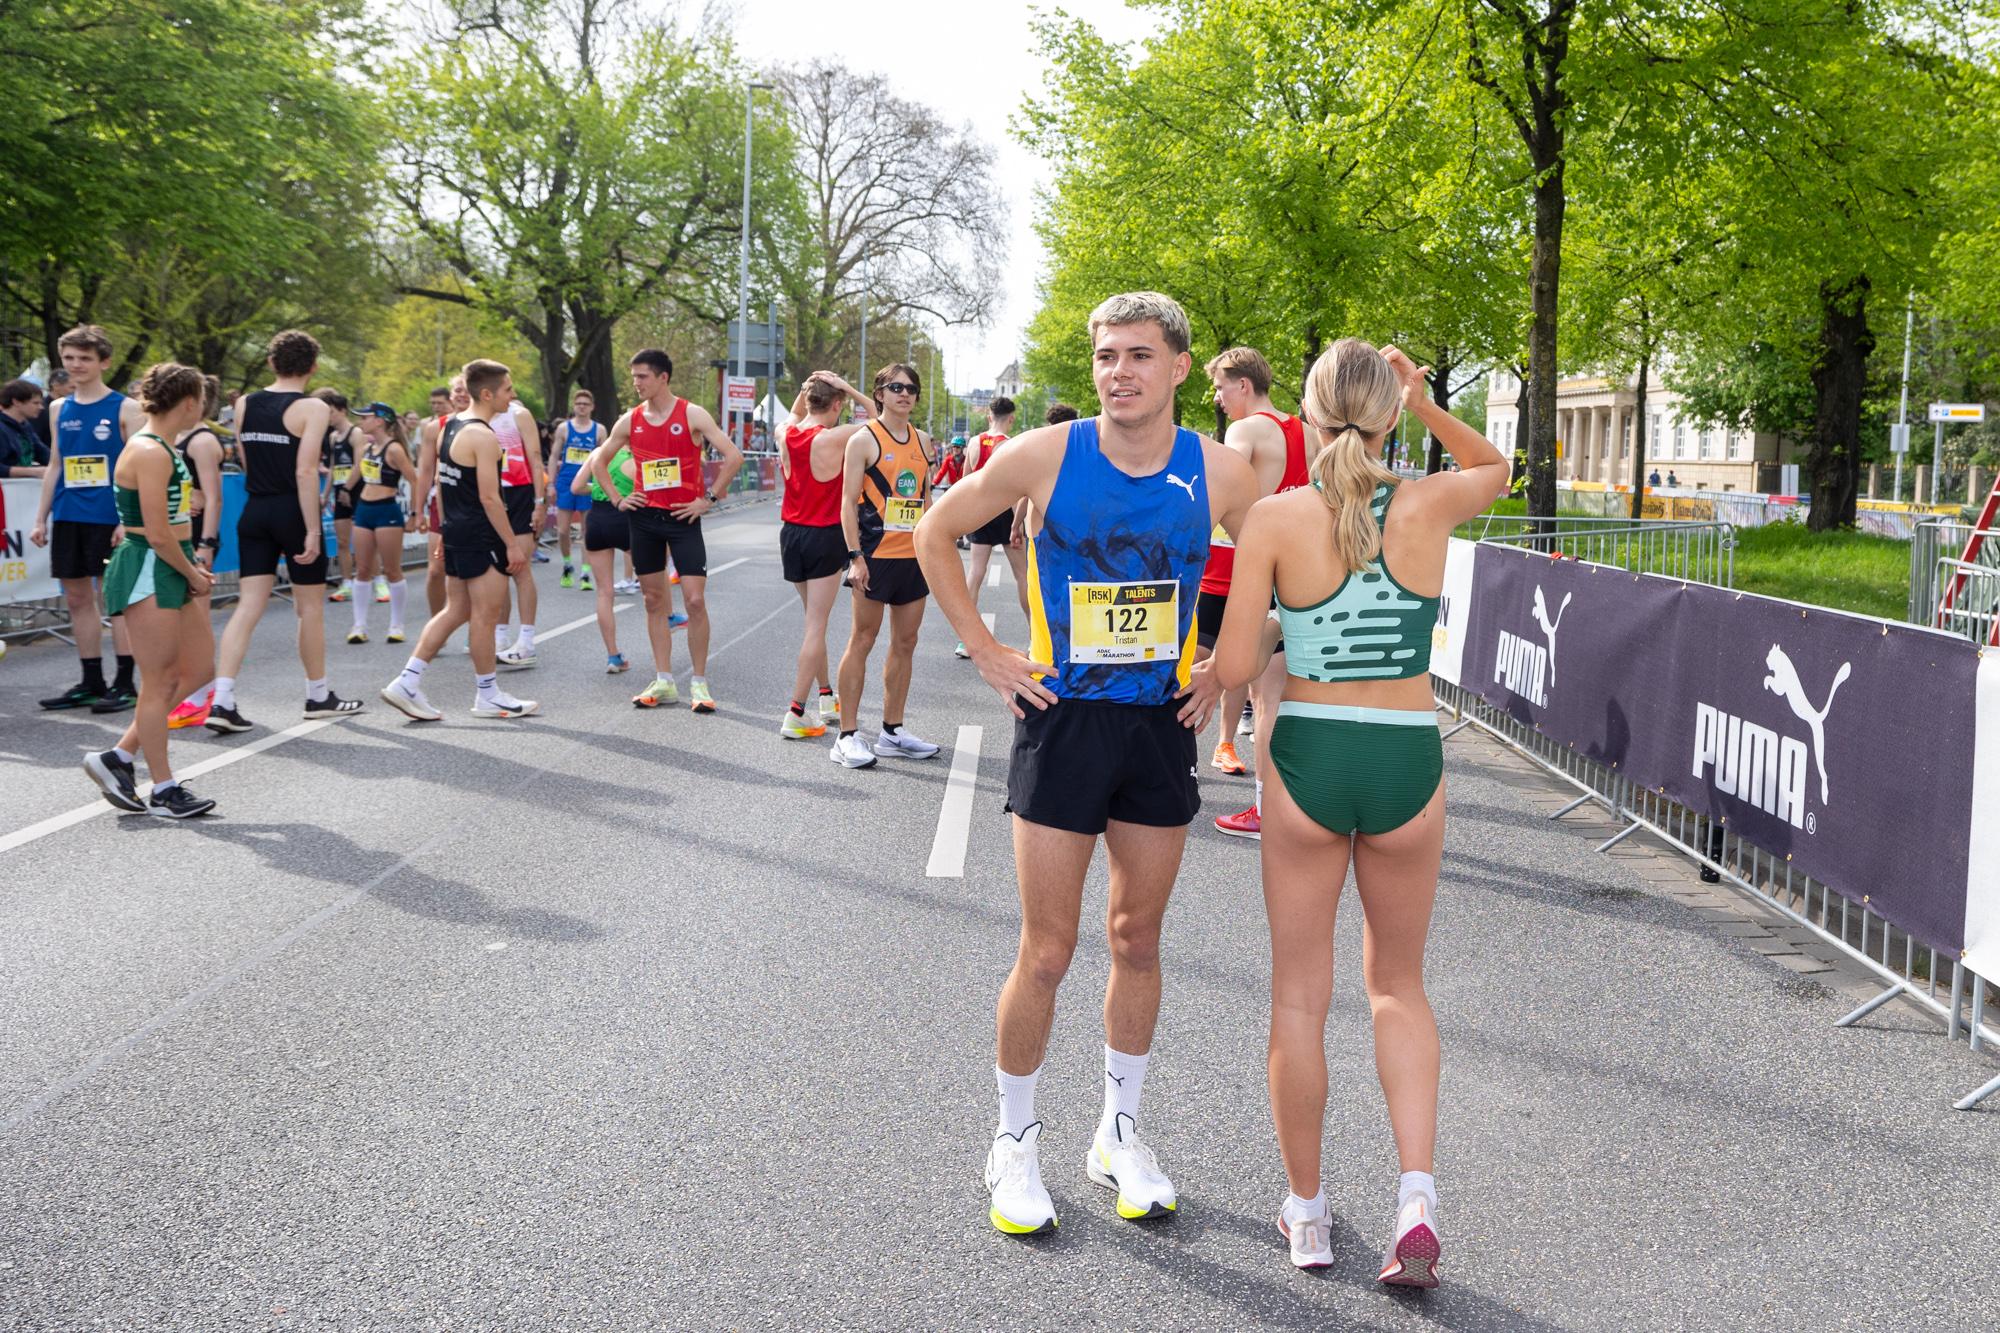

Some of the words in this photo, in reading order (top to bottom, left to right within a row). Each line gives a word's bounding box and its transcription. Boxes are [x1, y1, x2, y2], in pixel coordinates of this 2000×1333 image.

[73, 465, 92, 475] 114
[653, 467, 669, 479] 142
[897, 479, 916, 488] EAM
[900, 508, 916, 520] 118
[1125, 588, 1156, 598] TALENTS
[1105, 608, 1147, 632] 122
[1114, 635, 1138, 645] Tristan
[1493, 629, 1547, 707] PUMA
[1692, 701, 1808, 830] PUMA
